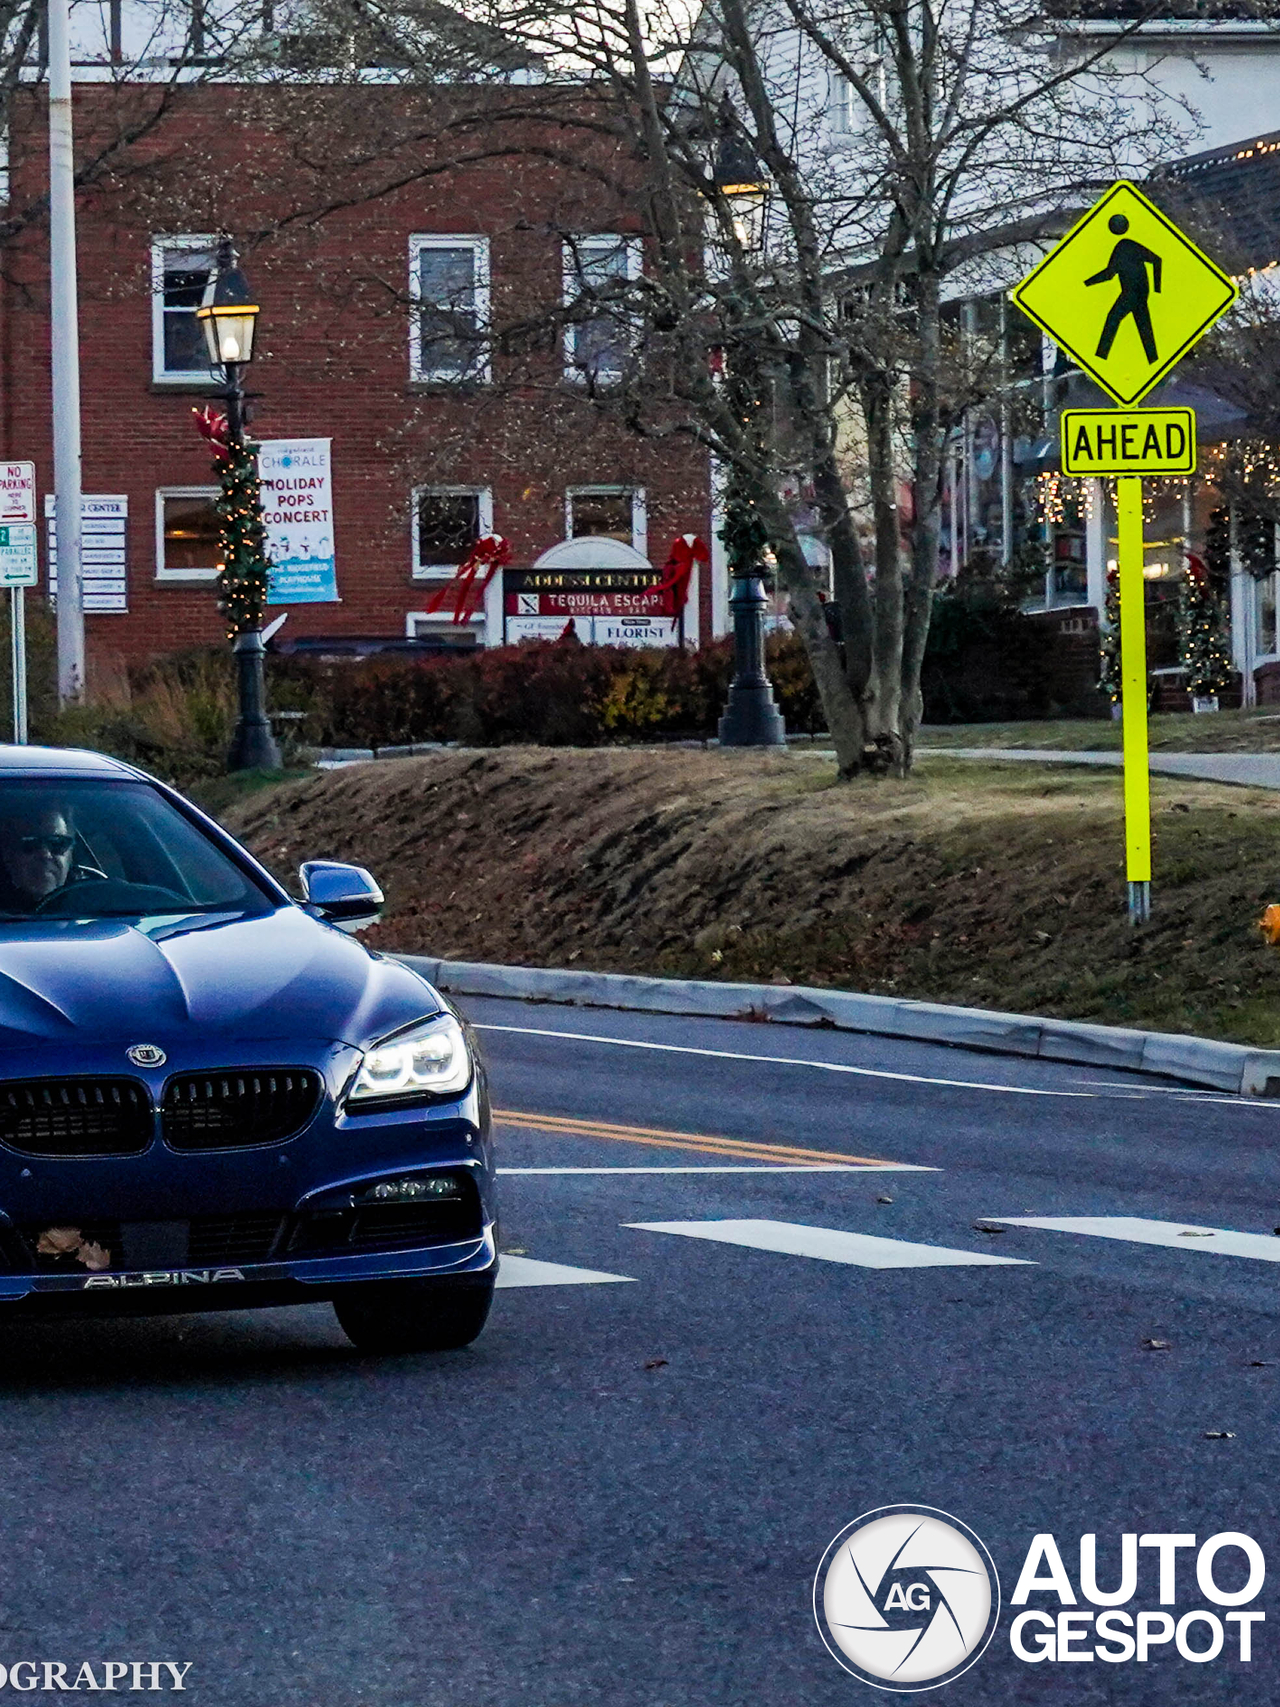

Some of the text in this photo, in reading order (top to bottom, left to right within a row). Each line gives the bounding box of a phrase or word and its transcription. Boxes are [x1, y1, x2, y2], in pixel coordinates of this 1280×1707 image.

[1073, 423, 1186, 460] AHEAD
[7, 466, 22, 478] NO
[266, 477, 325, 491] HOLIDAY
[278, 494, 314, 507] POPS
[88, 504, 122, 513] CENTER
[264, 509, 329, 525] CONCERT
[595, 573, 663, 587] CENTER
[549, 594, 608, 607] TEQUILA
[607, 627, 665, 639] FLORIST
[83, 1268, 245, 1290] ALPINA
